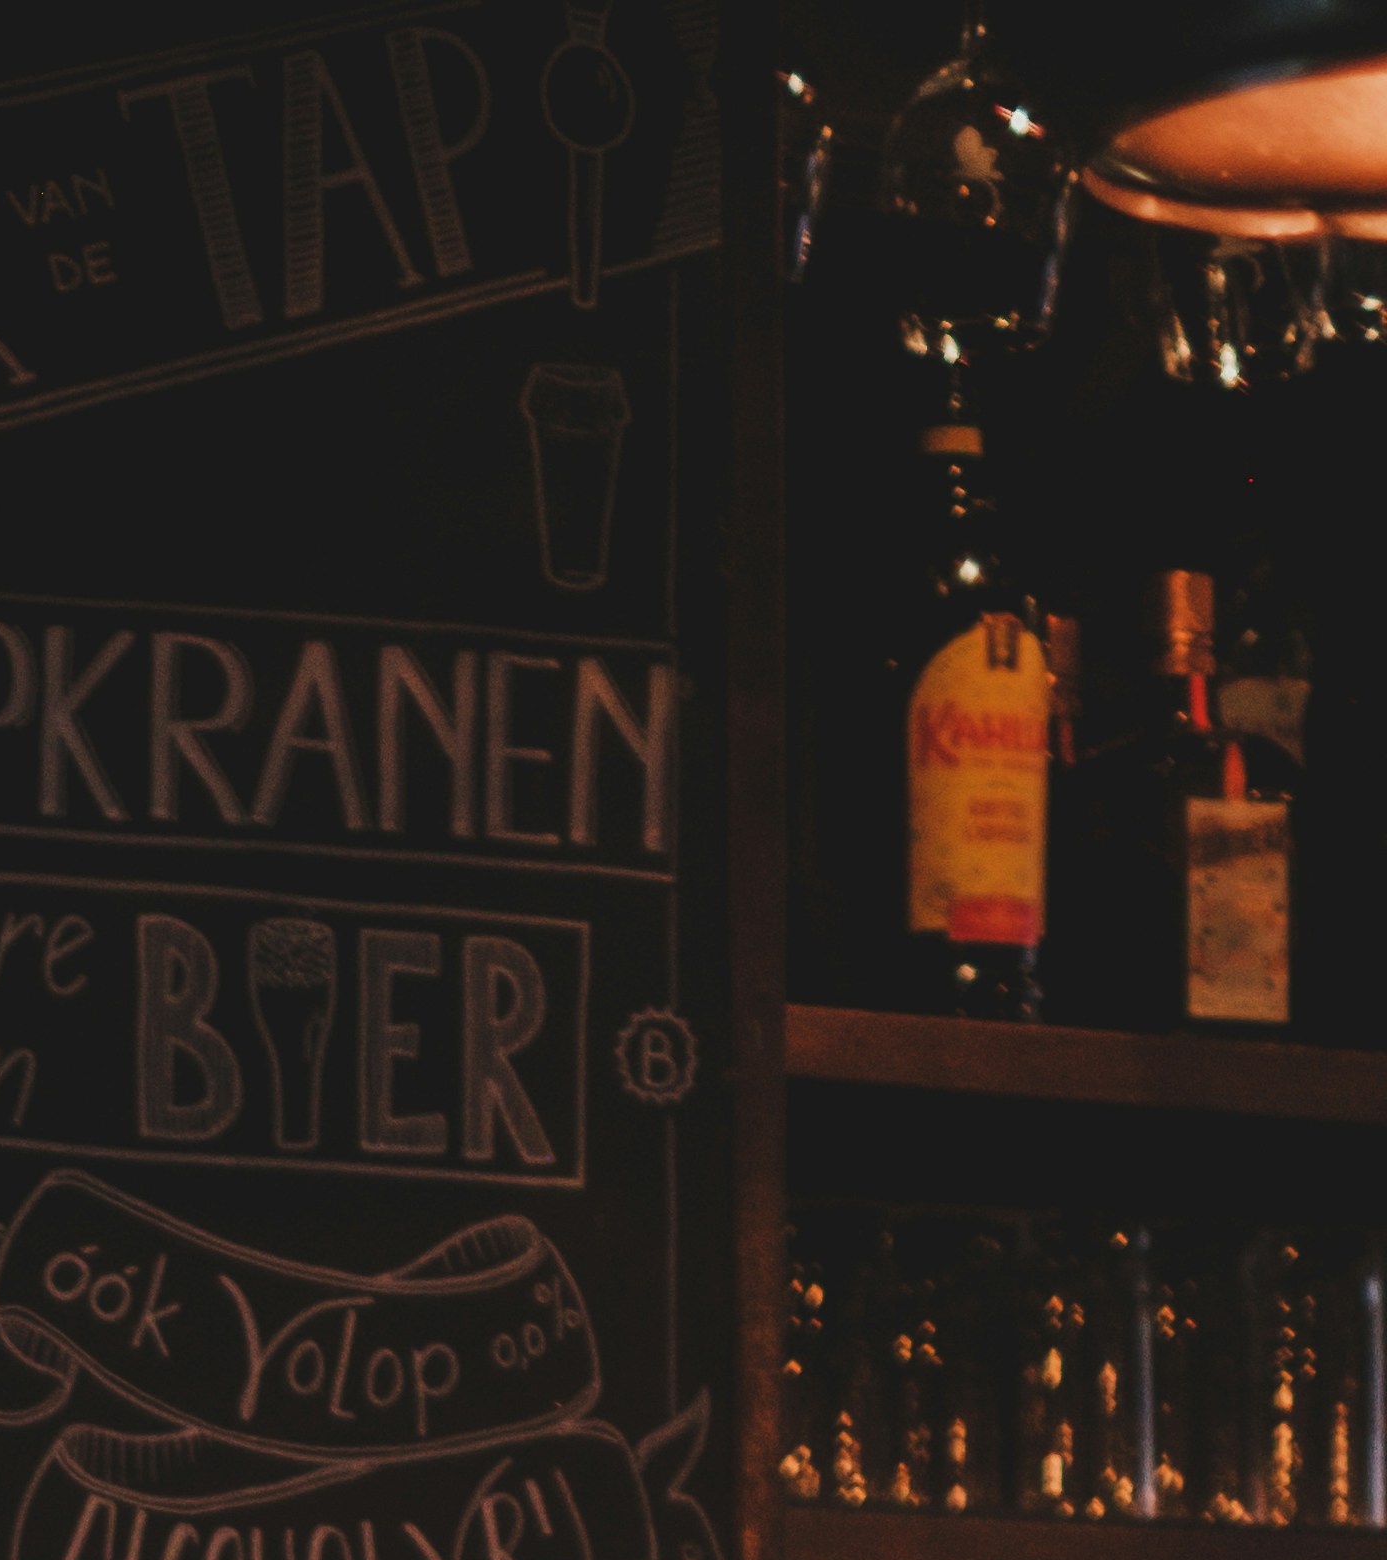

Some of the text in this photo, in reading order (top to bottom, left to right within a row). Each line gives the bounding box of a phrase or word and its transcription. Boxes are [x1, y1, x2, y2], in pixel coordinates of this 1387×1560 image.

[7, 166, 116, 229] VAN
[117, 25, 492, 330] TAP
[47, 240, 118, 295] DE
